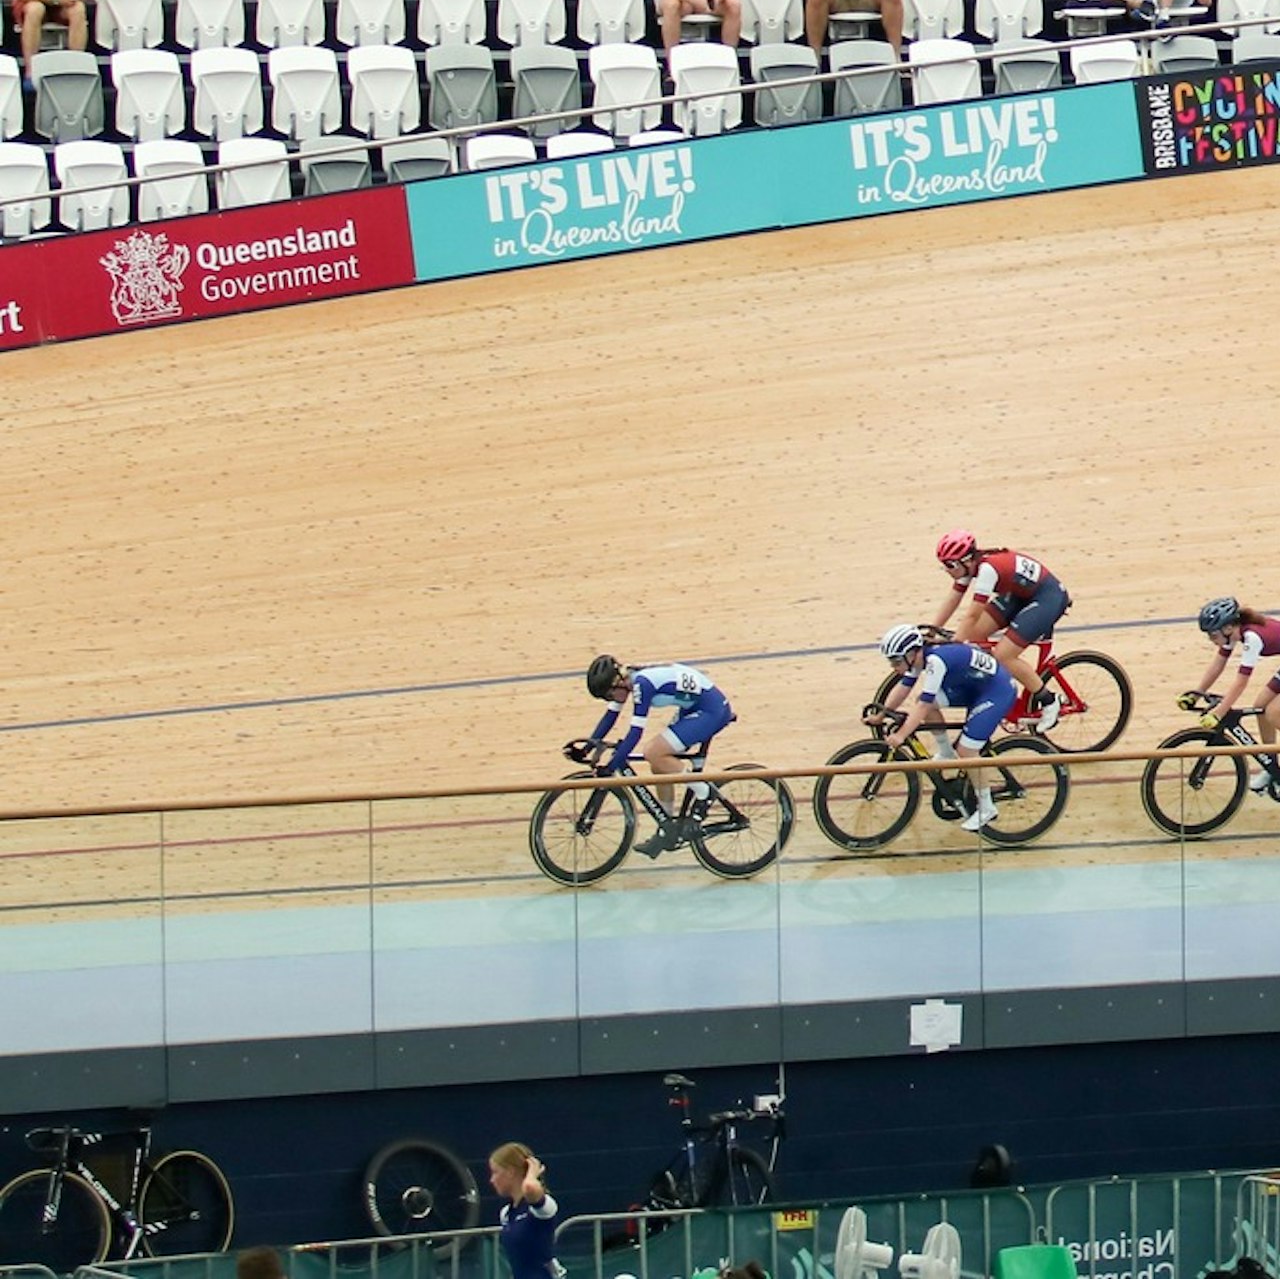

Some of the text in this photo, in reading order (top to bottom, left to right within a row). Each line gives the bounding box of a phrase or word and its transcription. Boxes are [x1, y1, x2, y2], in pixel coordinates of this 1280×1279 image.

[939, 96, 1059, 156] LIVE!
[1148, 83, 1177, 169] BRISBANE
[576, 147, 695, 210] LIVE!
[858, 139, 1047, 205] in Queensland
[197, 220, 357, 271] Queensland
[494, 190, 684, 257] in Queensland
[201, 255, 361, 302] Government
[682, 673, 697, 690] 86
[783, 1210, 808, 1222] TFH
